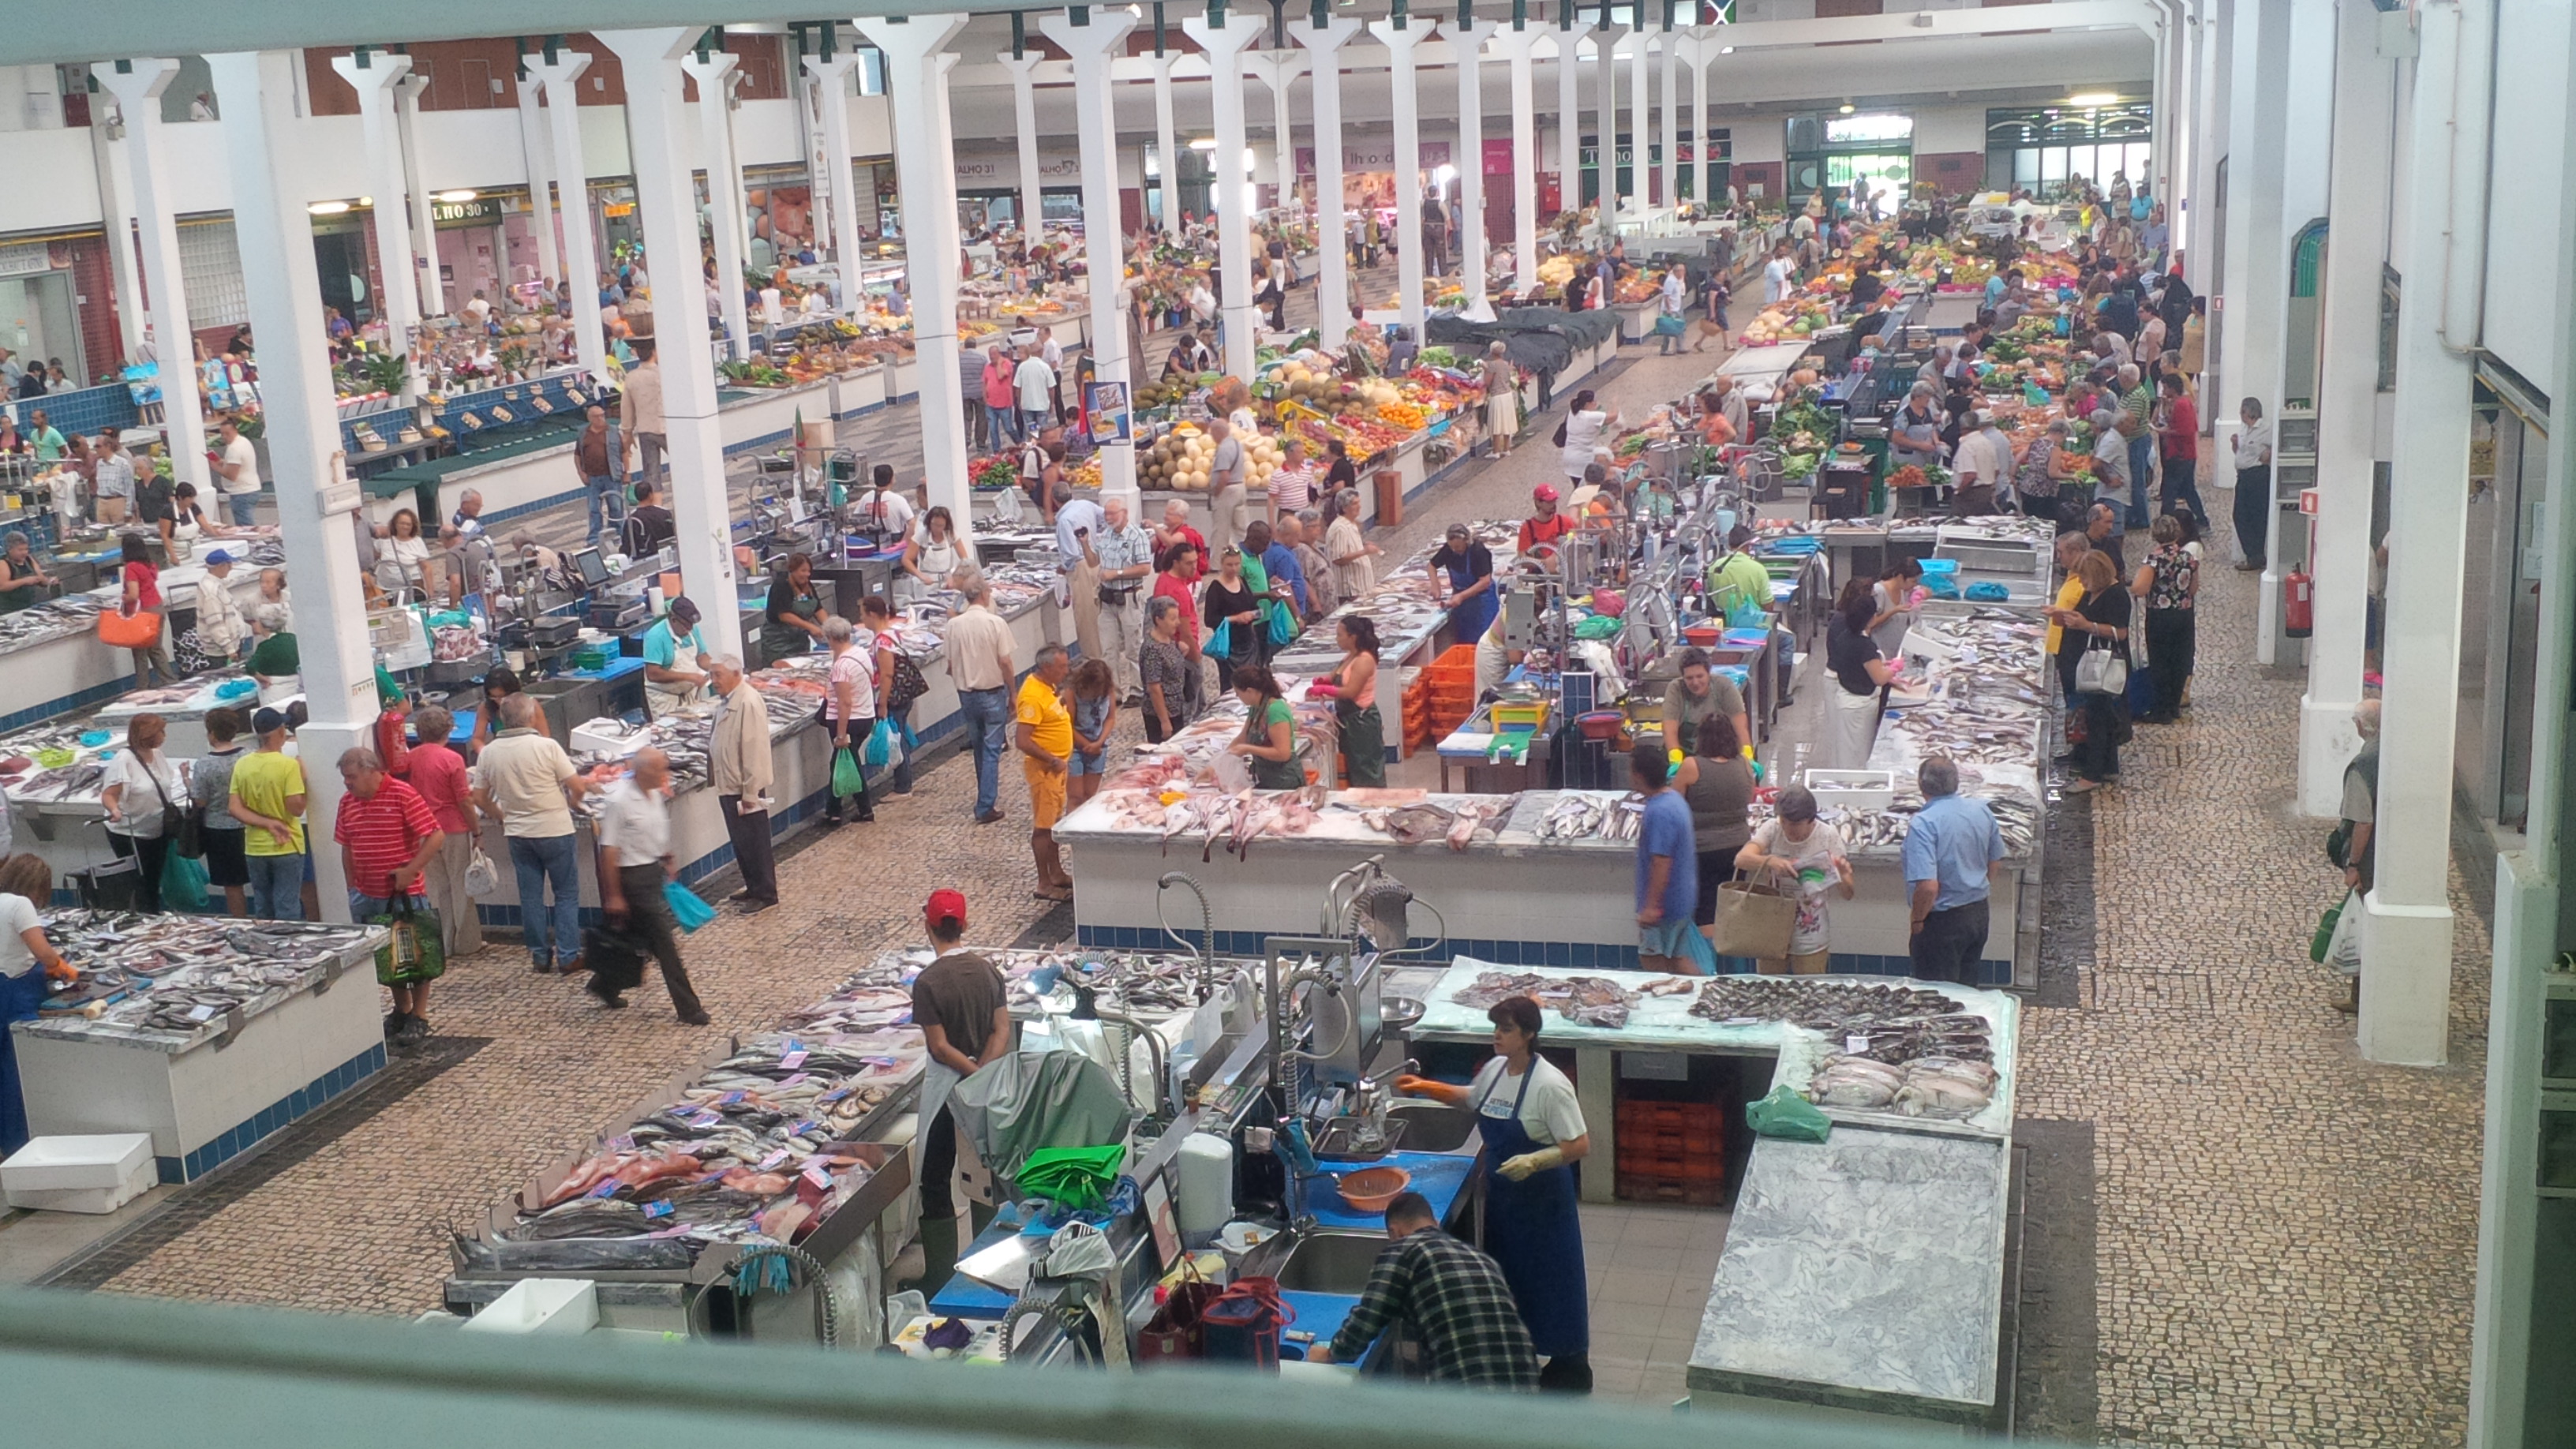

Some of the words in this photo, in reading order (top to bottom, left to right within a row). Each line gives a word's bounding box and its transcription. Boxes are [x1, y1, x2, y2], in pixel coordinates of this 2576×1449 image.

[957, 164, 983, 174] ALHO
[432, 204, 463, 220] LHO
[466, 204, 481, 217] 30
